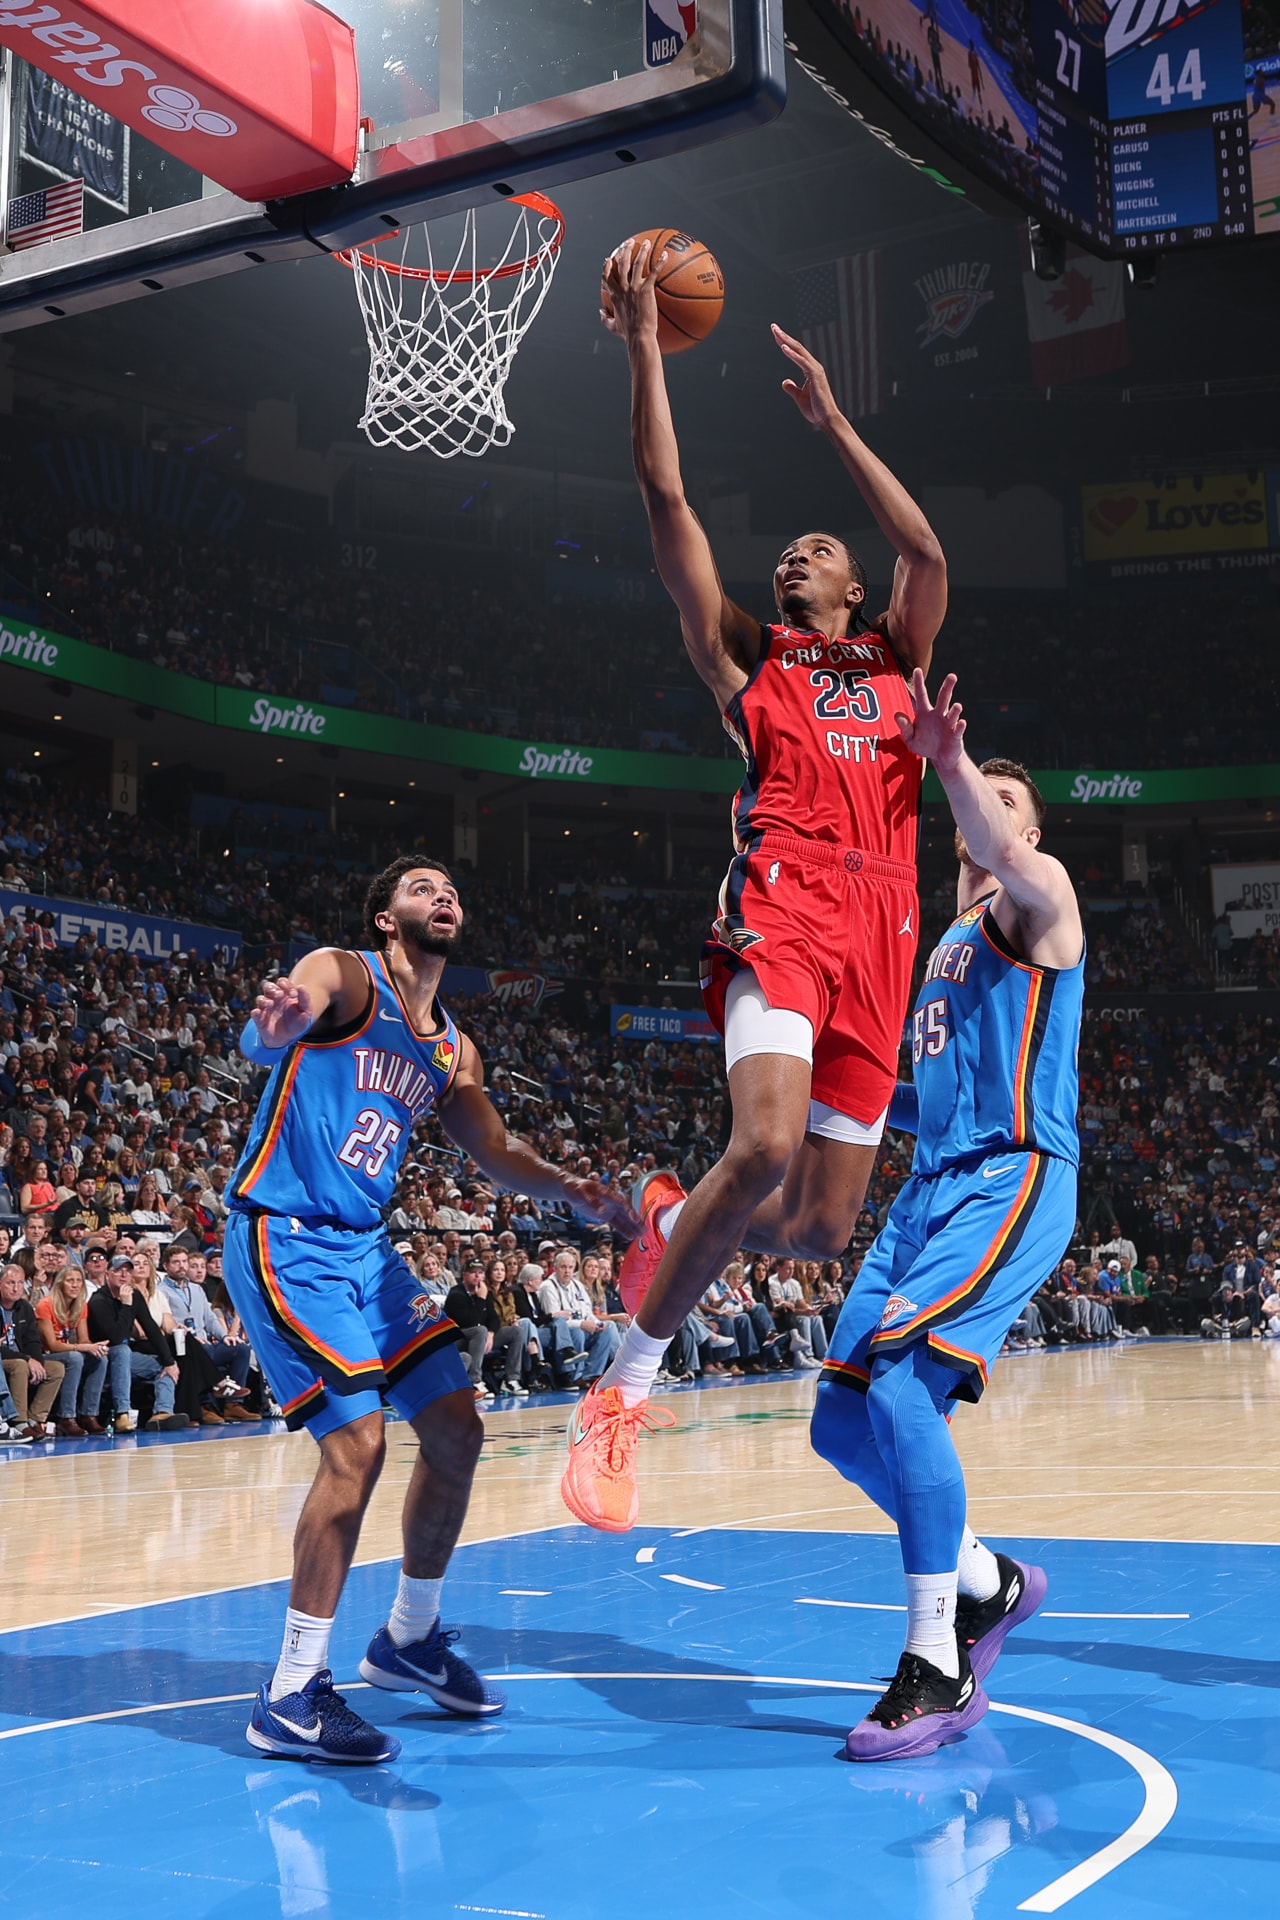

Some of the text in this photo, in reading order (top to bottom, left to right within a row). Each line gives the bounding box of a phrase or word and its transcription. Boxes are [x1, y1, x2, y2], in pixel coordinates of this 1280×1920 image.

[652, 35, 678, 62] NBA
[1055, 29, 1081, 93] 27
[1146, 48, 1206, 106] 44
[38, 110, 114, 161] CHAMPIONS
[1113, 108, 1245, 137] PLAYER PTS FL
[1113, 127, 1243, 156] CARUSO 8 0
[1114, 145, 1244, 175] DIENG 0 0
[1115, 164, 1246, 193] WIGGINS 8 0
[1116, 183, 1247, 212] MITCHELL 0 0
[1117, 202, 1247, 230] HARTENSTEIN 4 1
[1125, 223, 1245, 249] TO 6 TF 0 2ND 9:40
[913, 261, 991, 303] THUNDER
[934, 352, 953, 367] EST.
[32, 437, 248, 538] THUNDER
[341, 544, 377, 570] 312
[1111, 561, 1169, 578] BRING
[1175, 558, 1212, 572] THE
[616, 577, 646, 601] 313
[0, 621, 59, 668] prite
[781, 641, 885, 670] CRECENT
[809, 668, 881, 723] 25
[249, 698, 326, 735] Sprite
[519, 746, 593, 777] Sprite
[826, 730, 880, 763] CITY
[119, 759, 130, 806] 210
[1070, 774, 1143, 803] Sprite
[0, 902, 181, 958] SETBALL
[1264, 913, 1280, 927] PO
[632, 1015, 657, 1032] FREE
[659, 1018, 681, 1034] TACO
[912, 997, 949, 1066] 55
[353, 1048, 437, 1119] THUNDE
[339, 1107, 404, 1178] 25
